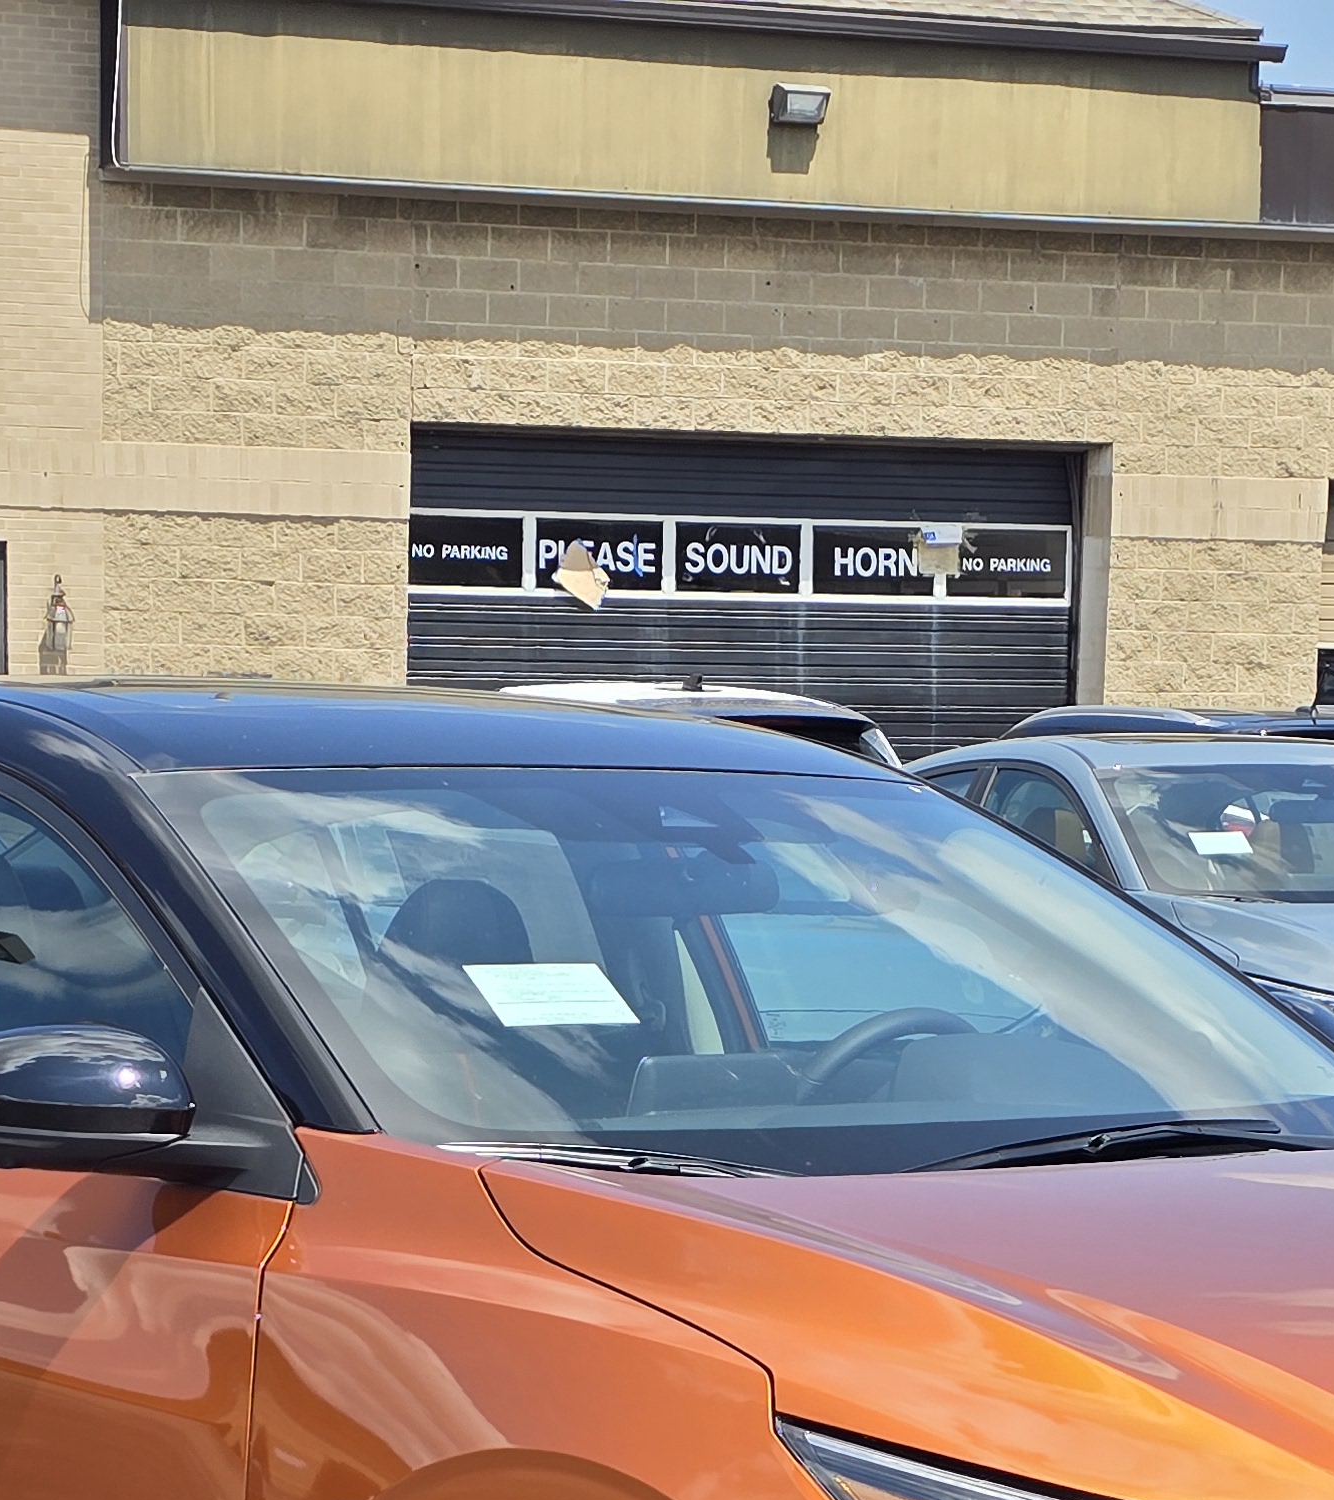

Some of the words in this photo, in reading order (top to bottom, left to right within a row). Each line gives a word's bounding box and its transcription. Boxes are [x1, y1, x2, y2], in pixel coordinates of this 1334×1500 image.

[411, 543, 435, 558] NO
[441, 543, 509, 560] PARKING
[539, 539, 656, 573] PASE
[685, 542, 792, 575] SOUND
[834, 547, 918, 577] HORN
[962, 557, 984, 571] NO
[989, 557, 1051, 572] PARKING
